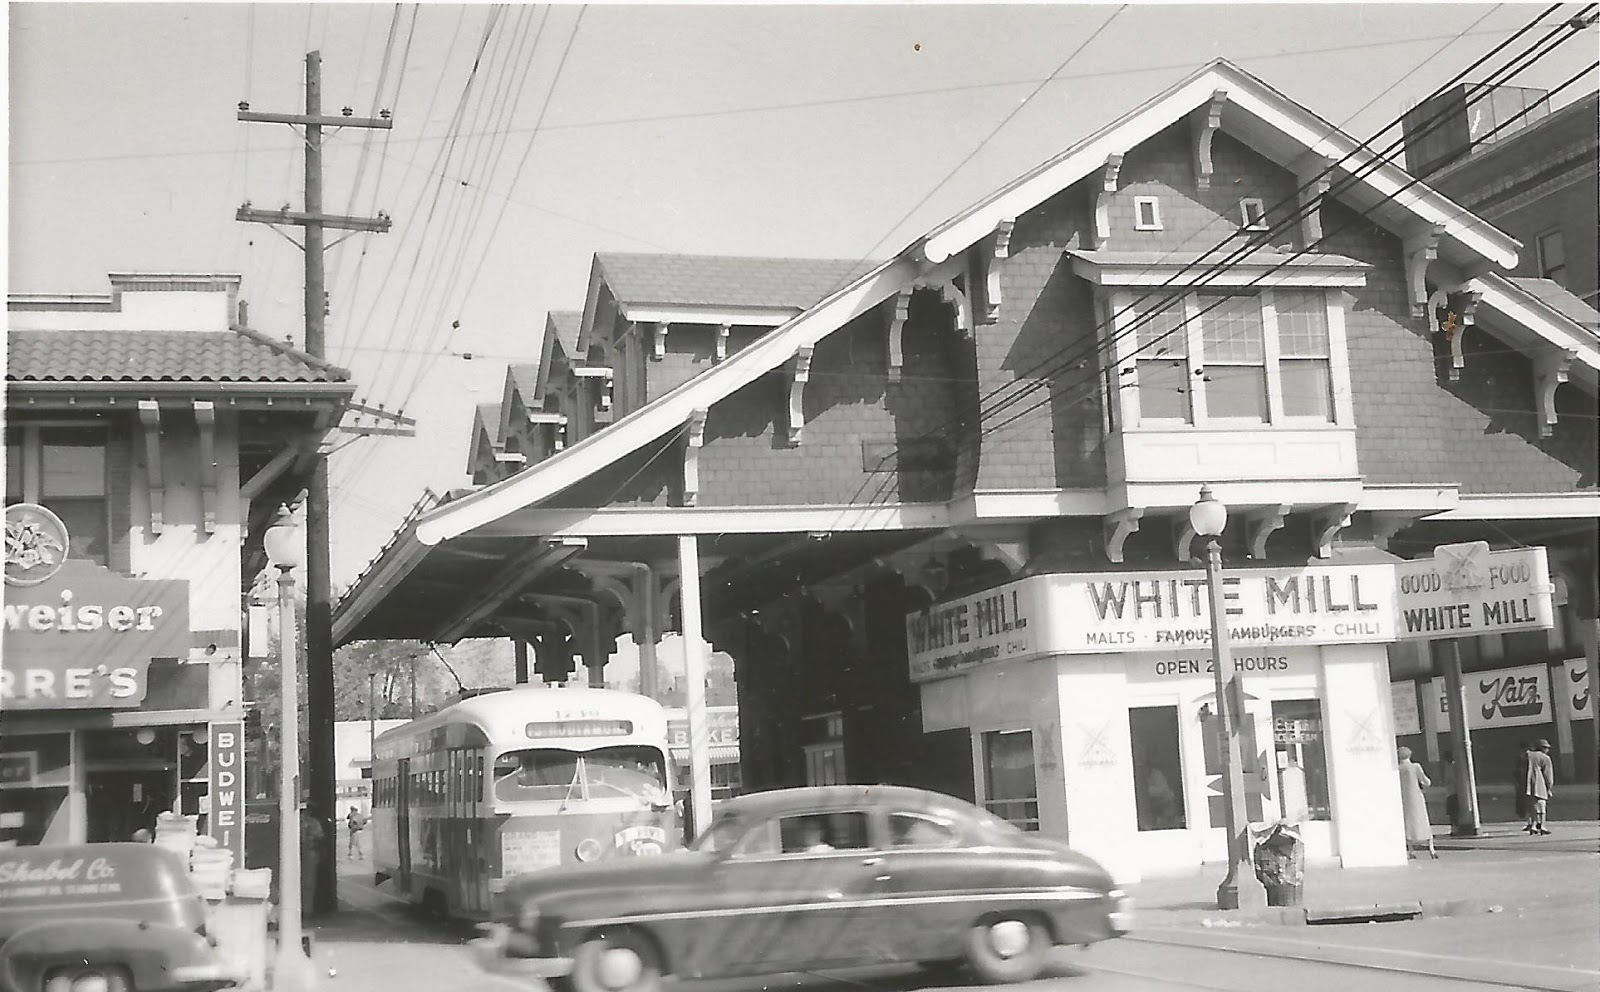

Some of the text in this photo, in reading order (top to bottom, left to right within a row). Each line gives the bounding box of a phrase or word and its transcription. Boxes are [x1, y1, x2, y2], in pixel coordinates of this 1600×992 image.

[1401, 562, 1531, 594] GOOD FOOD
[1087, 574, 1378, 620] WHITE MILL
[909, 590, 1027, 655] WHITE MILL
[1403, 598, 1536, 632] WHITE MILL
[1086, 622, 1380, 645] MALTS FAMOUS AMBURGERS CHILI
[1155, 660, 1199, 675] OPEN
[1232, 657, 1288, 672] HOURS
[1480, 676, 1544, 720] Katz
